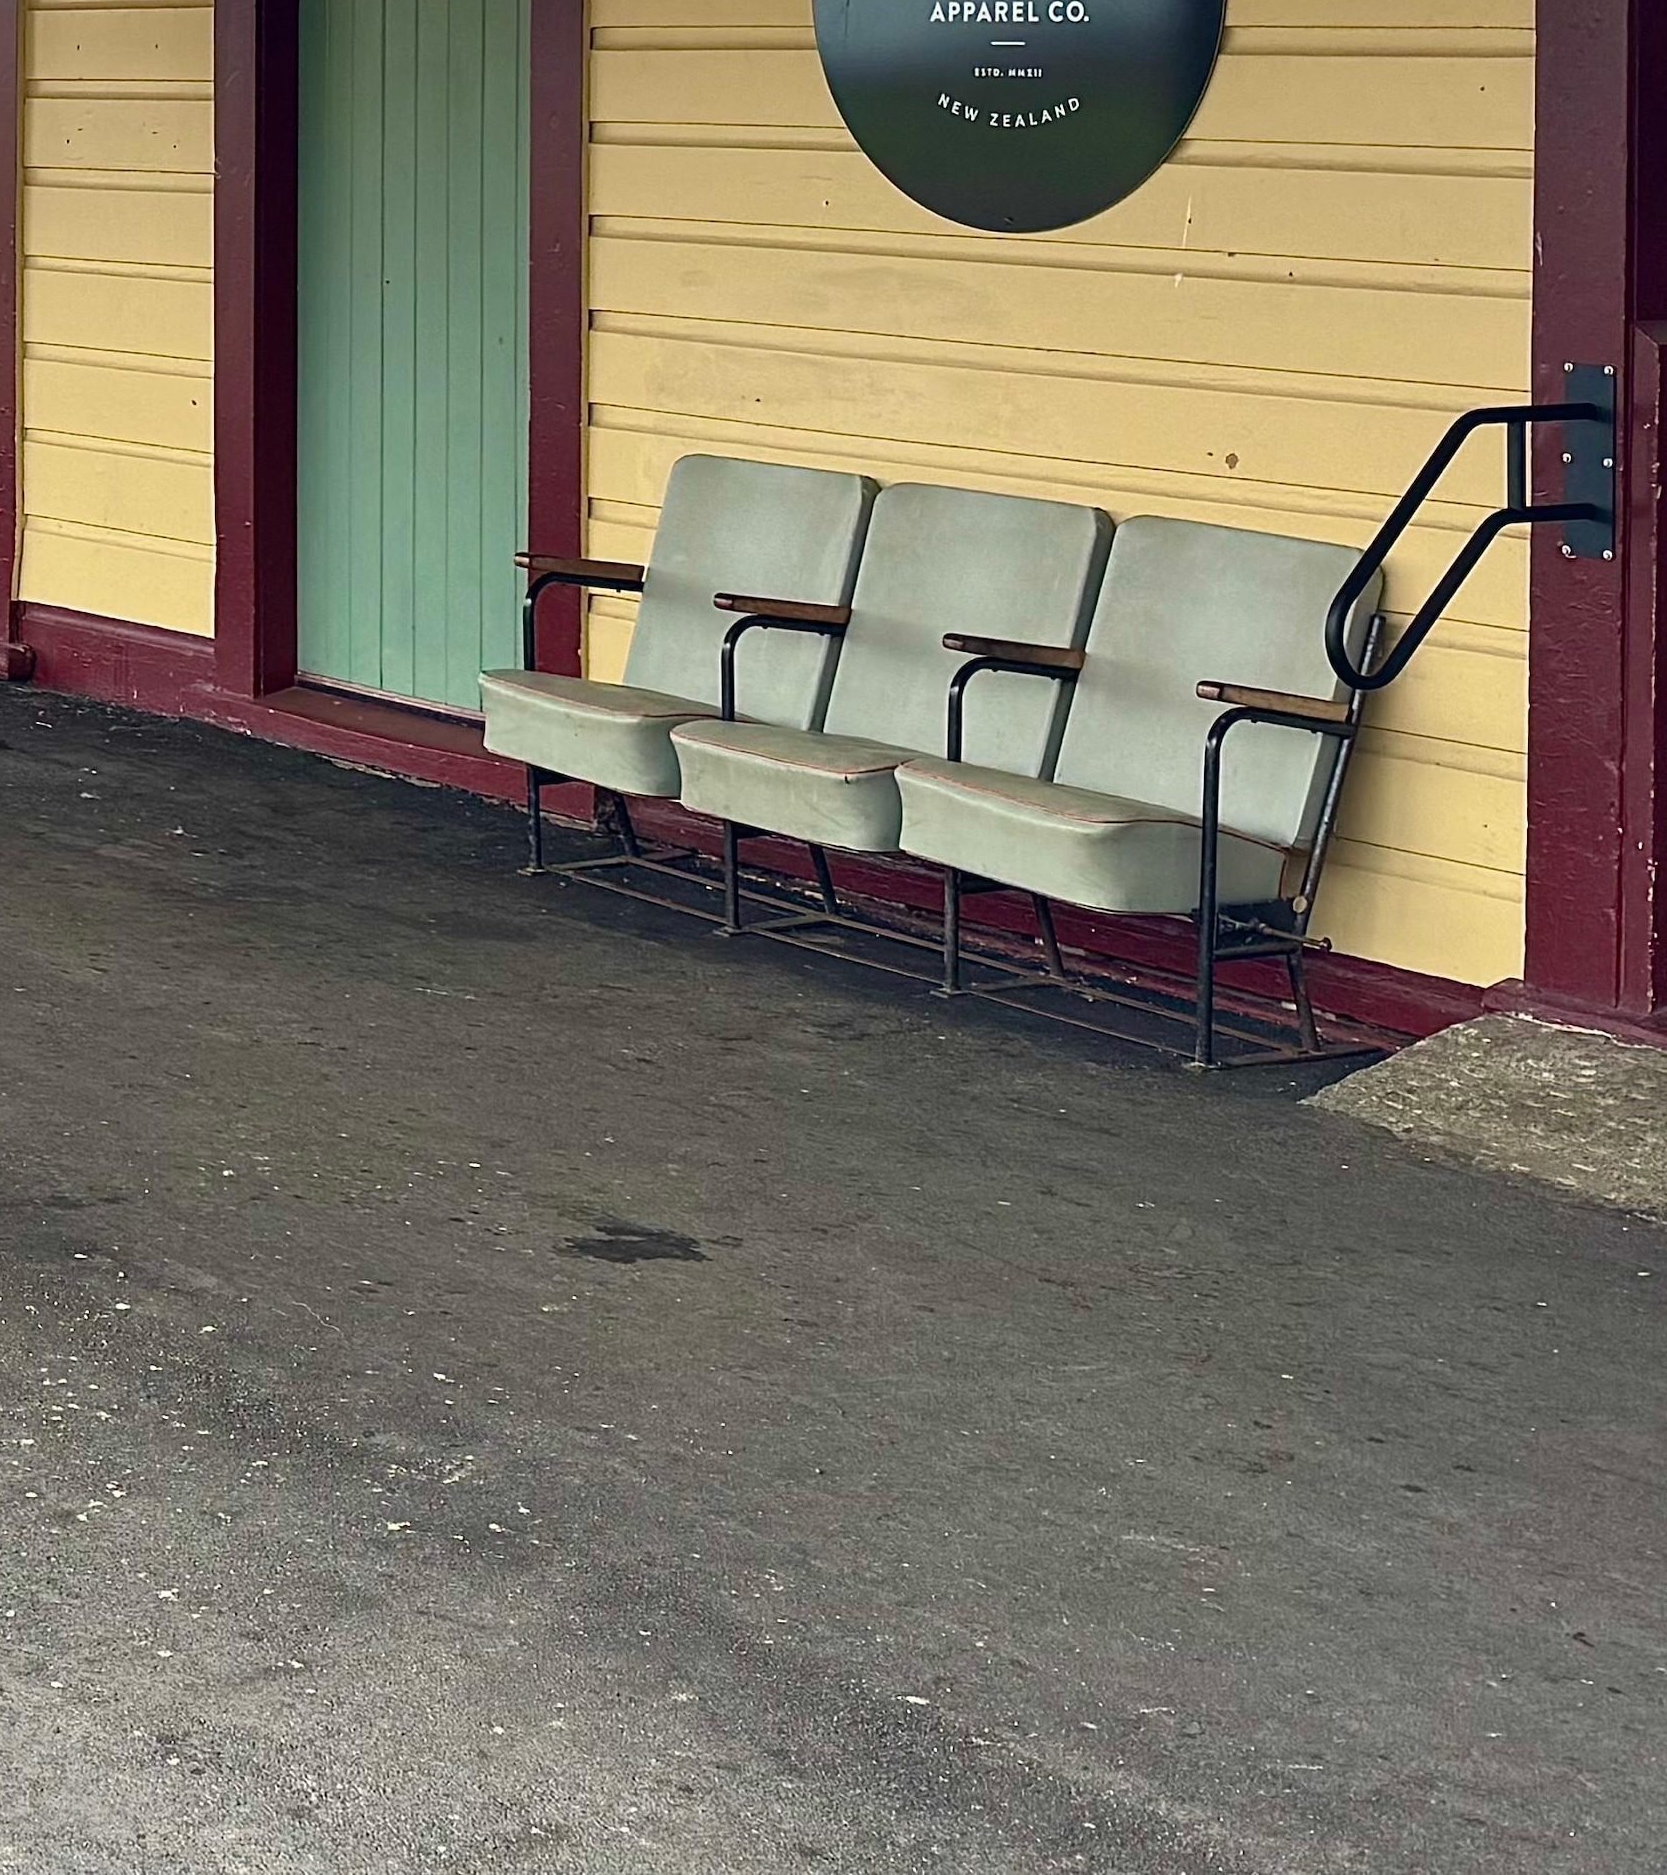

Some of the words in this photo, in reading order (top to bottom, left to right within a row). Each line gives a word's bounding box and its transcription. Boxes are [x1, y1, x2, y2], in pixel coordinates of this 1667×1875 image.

[930, 1, 1040, 23] APPAREL
[1048, 0, 1090, 23] CO.
[938, 93, 979, 121] NEW
[989, 97, 1080, 128] ZEALAND
